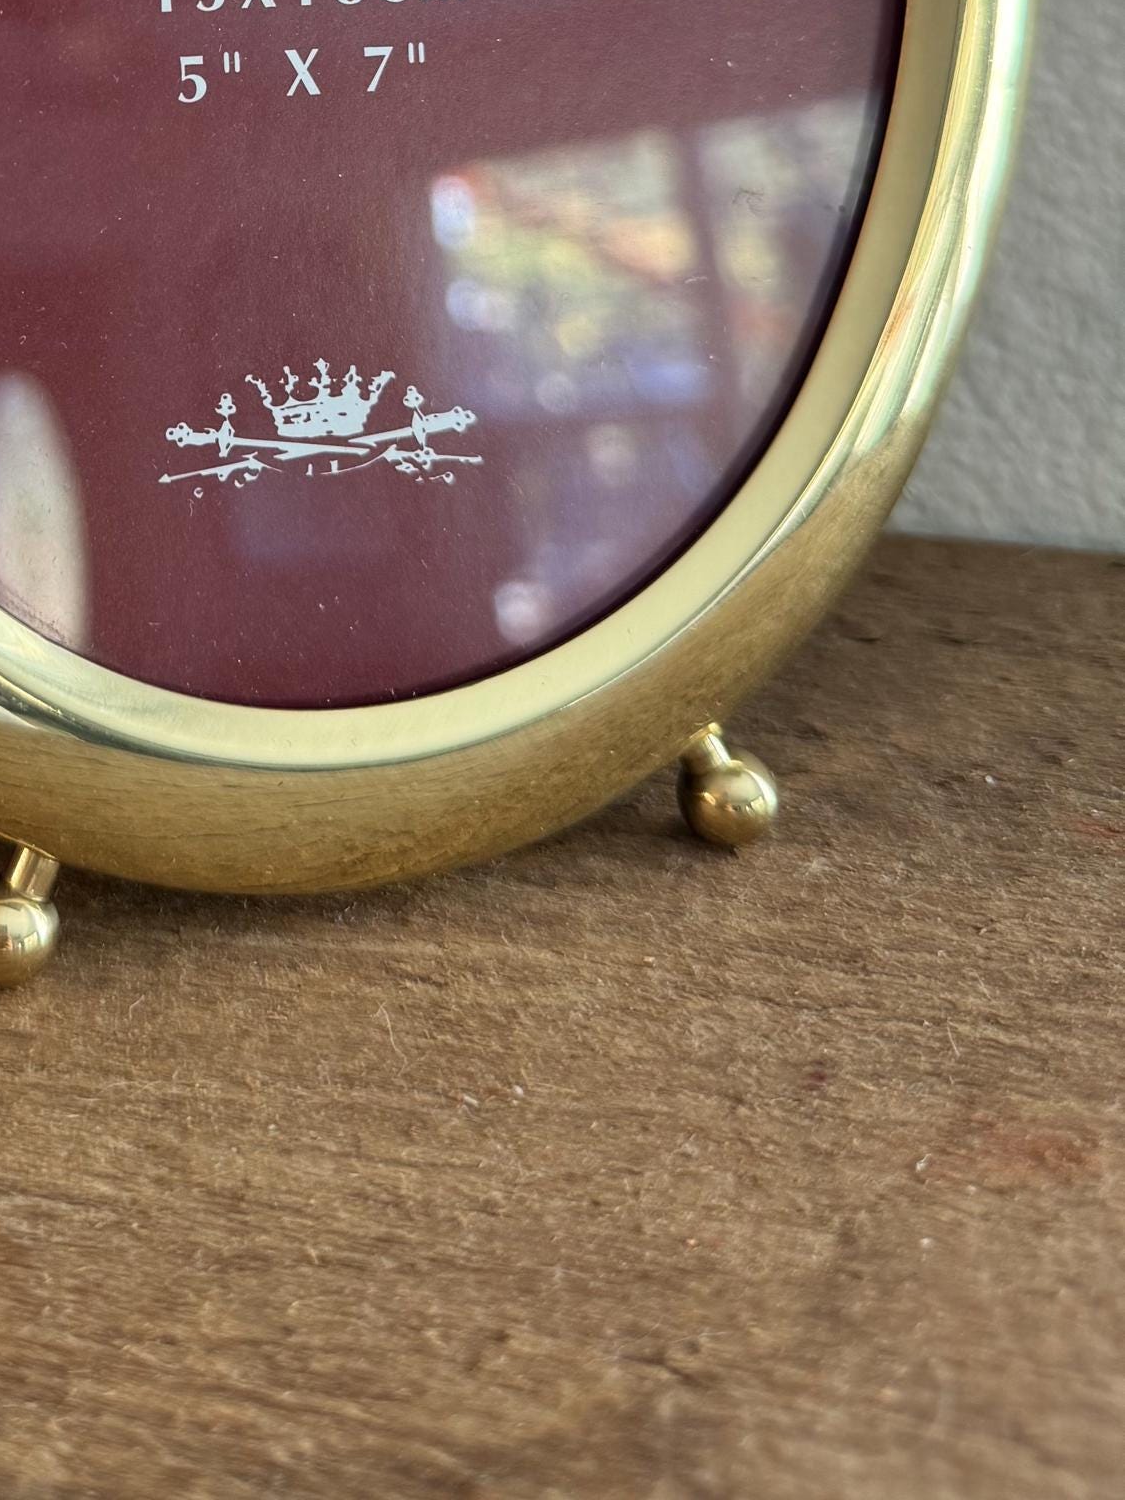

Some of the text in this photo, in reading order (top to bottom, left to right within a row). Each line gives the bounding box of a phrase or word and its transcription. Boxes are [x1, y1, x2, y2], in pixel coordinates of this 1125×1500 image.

[178, 41, 426, 103] 5" X 7"
